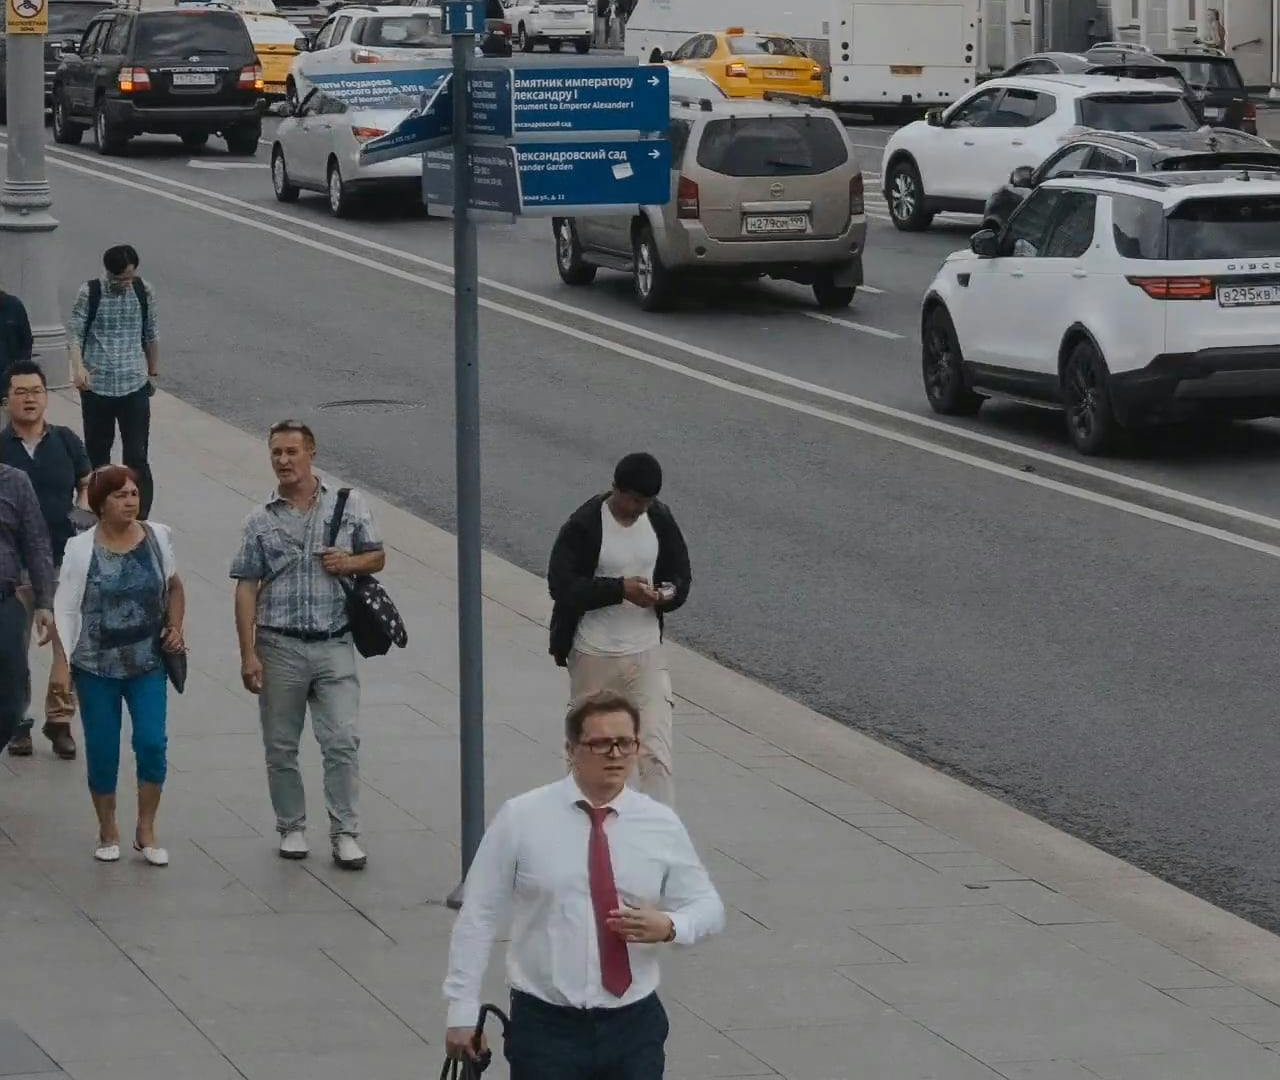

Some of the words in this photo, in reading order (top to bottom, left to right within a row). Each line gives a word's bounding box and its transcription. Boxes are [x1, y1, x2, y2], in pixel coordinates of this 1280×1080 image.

[514, 78, 563, 88] амятник
[565, 77, 634, 89] императору
[514, 90, 572, 102] лександру
[514, 102, 548, 111] onument
[549, 102, 558, 110] to
[559, 102, 591, 111] Emperor
[592, 101, 629, 110] Alexander
[517, 149, 605, 161] лександровский
[607, 150, 627, 161] сад
[520, 163, 545, 171] xander
[546, 163, 573, 171] Garden
